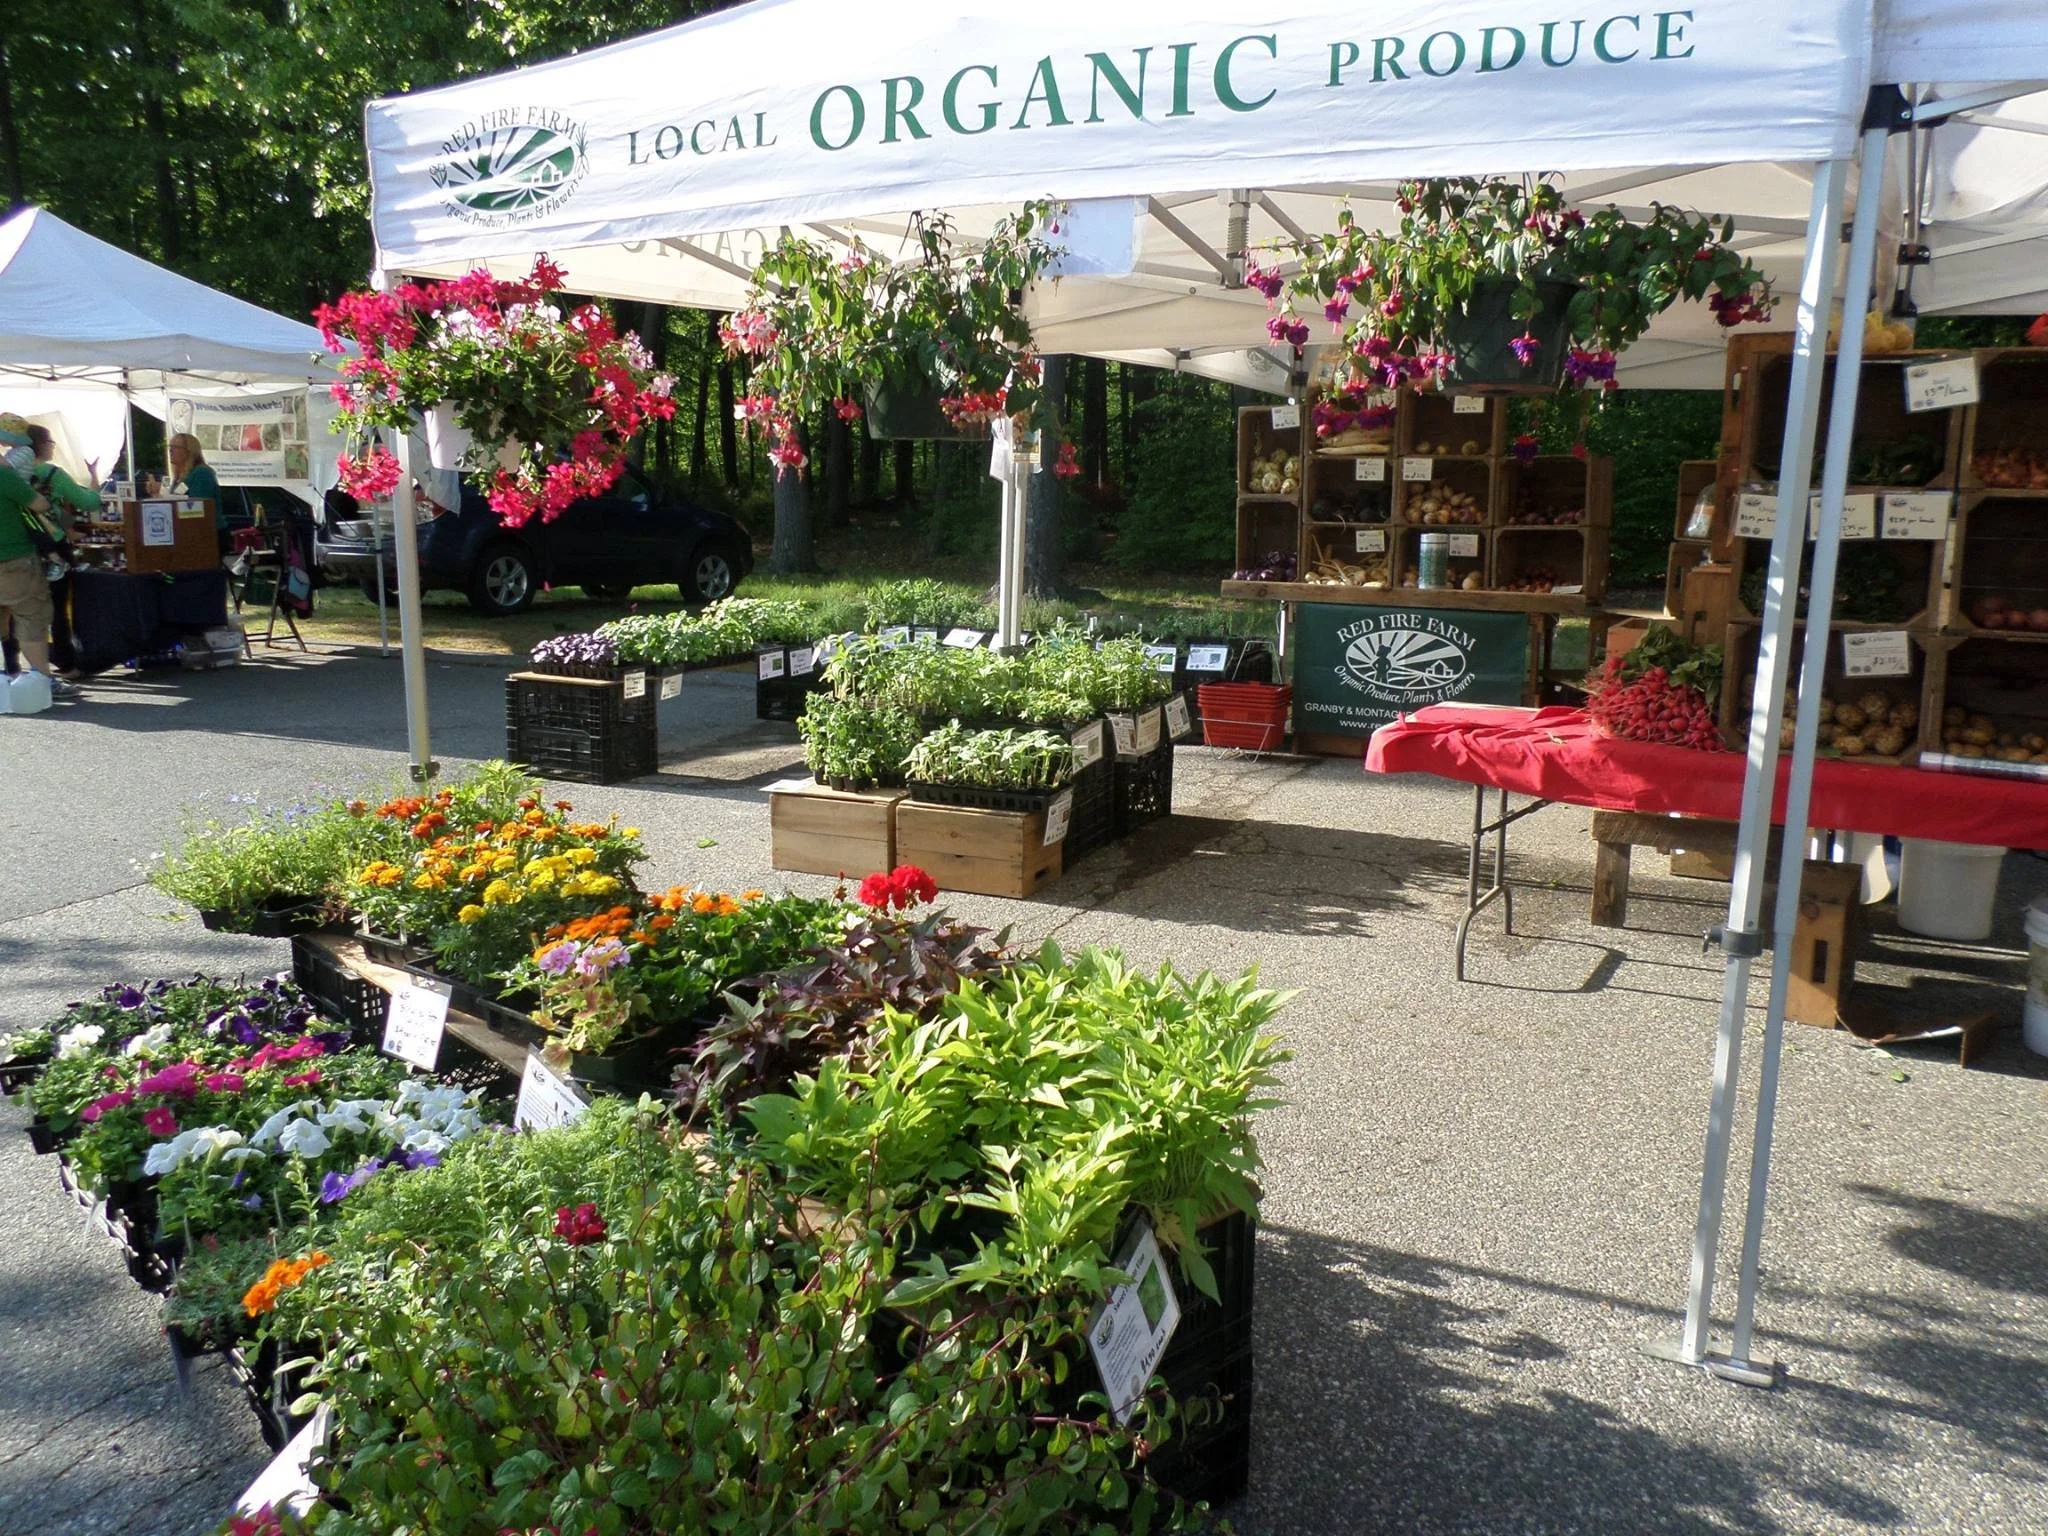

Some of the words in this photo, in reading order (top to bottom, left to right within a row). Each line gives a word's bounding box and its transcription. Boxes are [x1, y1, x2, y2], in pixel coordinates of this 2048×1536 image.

[627, 111, 777, 165] LOCAL
[808, 33, 1277, 152] ORGANIC
[1325, 10, 1696, 88] PRODUCE
[442, 121, 477, 155] RED
[480, 106, 520, 132] FIRE
[527, 106, 577, 140] FARM
[508, 212, 533, 226] Plants
[535, 205, 544, 219] &
[546, 178, 581, 215] Flowers
[1336, 618, 1374, 643] RED
[1378, 613, 1422, 629] FIRE
[1426, 617, 1476, 651] FARM
[1334, 665, 1366, 692] Organic
[1402, 690, 1435, 704] Plants
[1437, 688, 1445, 701] &
[1445, 672, 1476, 699] Flowers
[1304, 702, 1345, 714] GRANBY
[1346, 706, 1354, 716] &
[1355, 707, 1412, 719] MONTAGE
